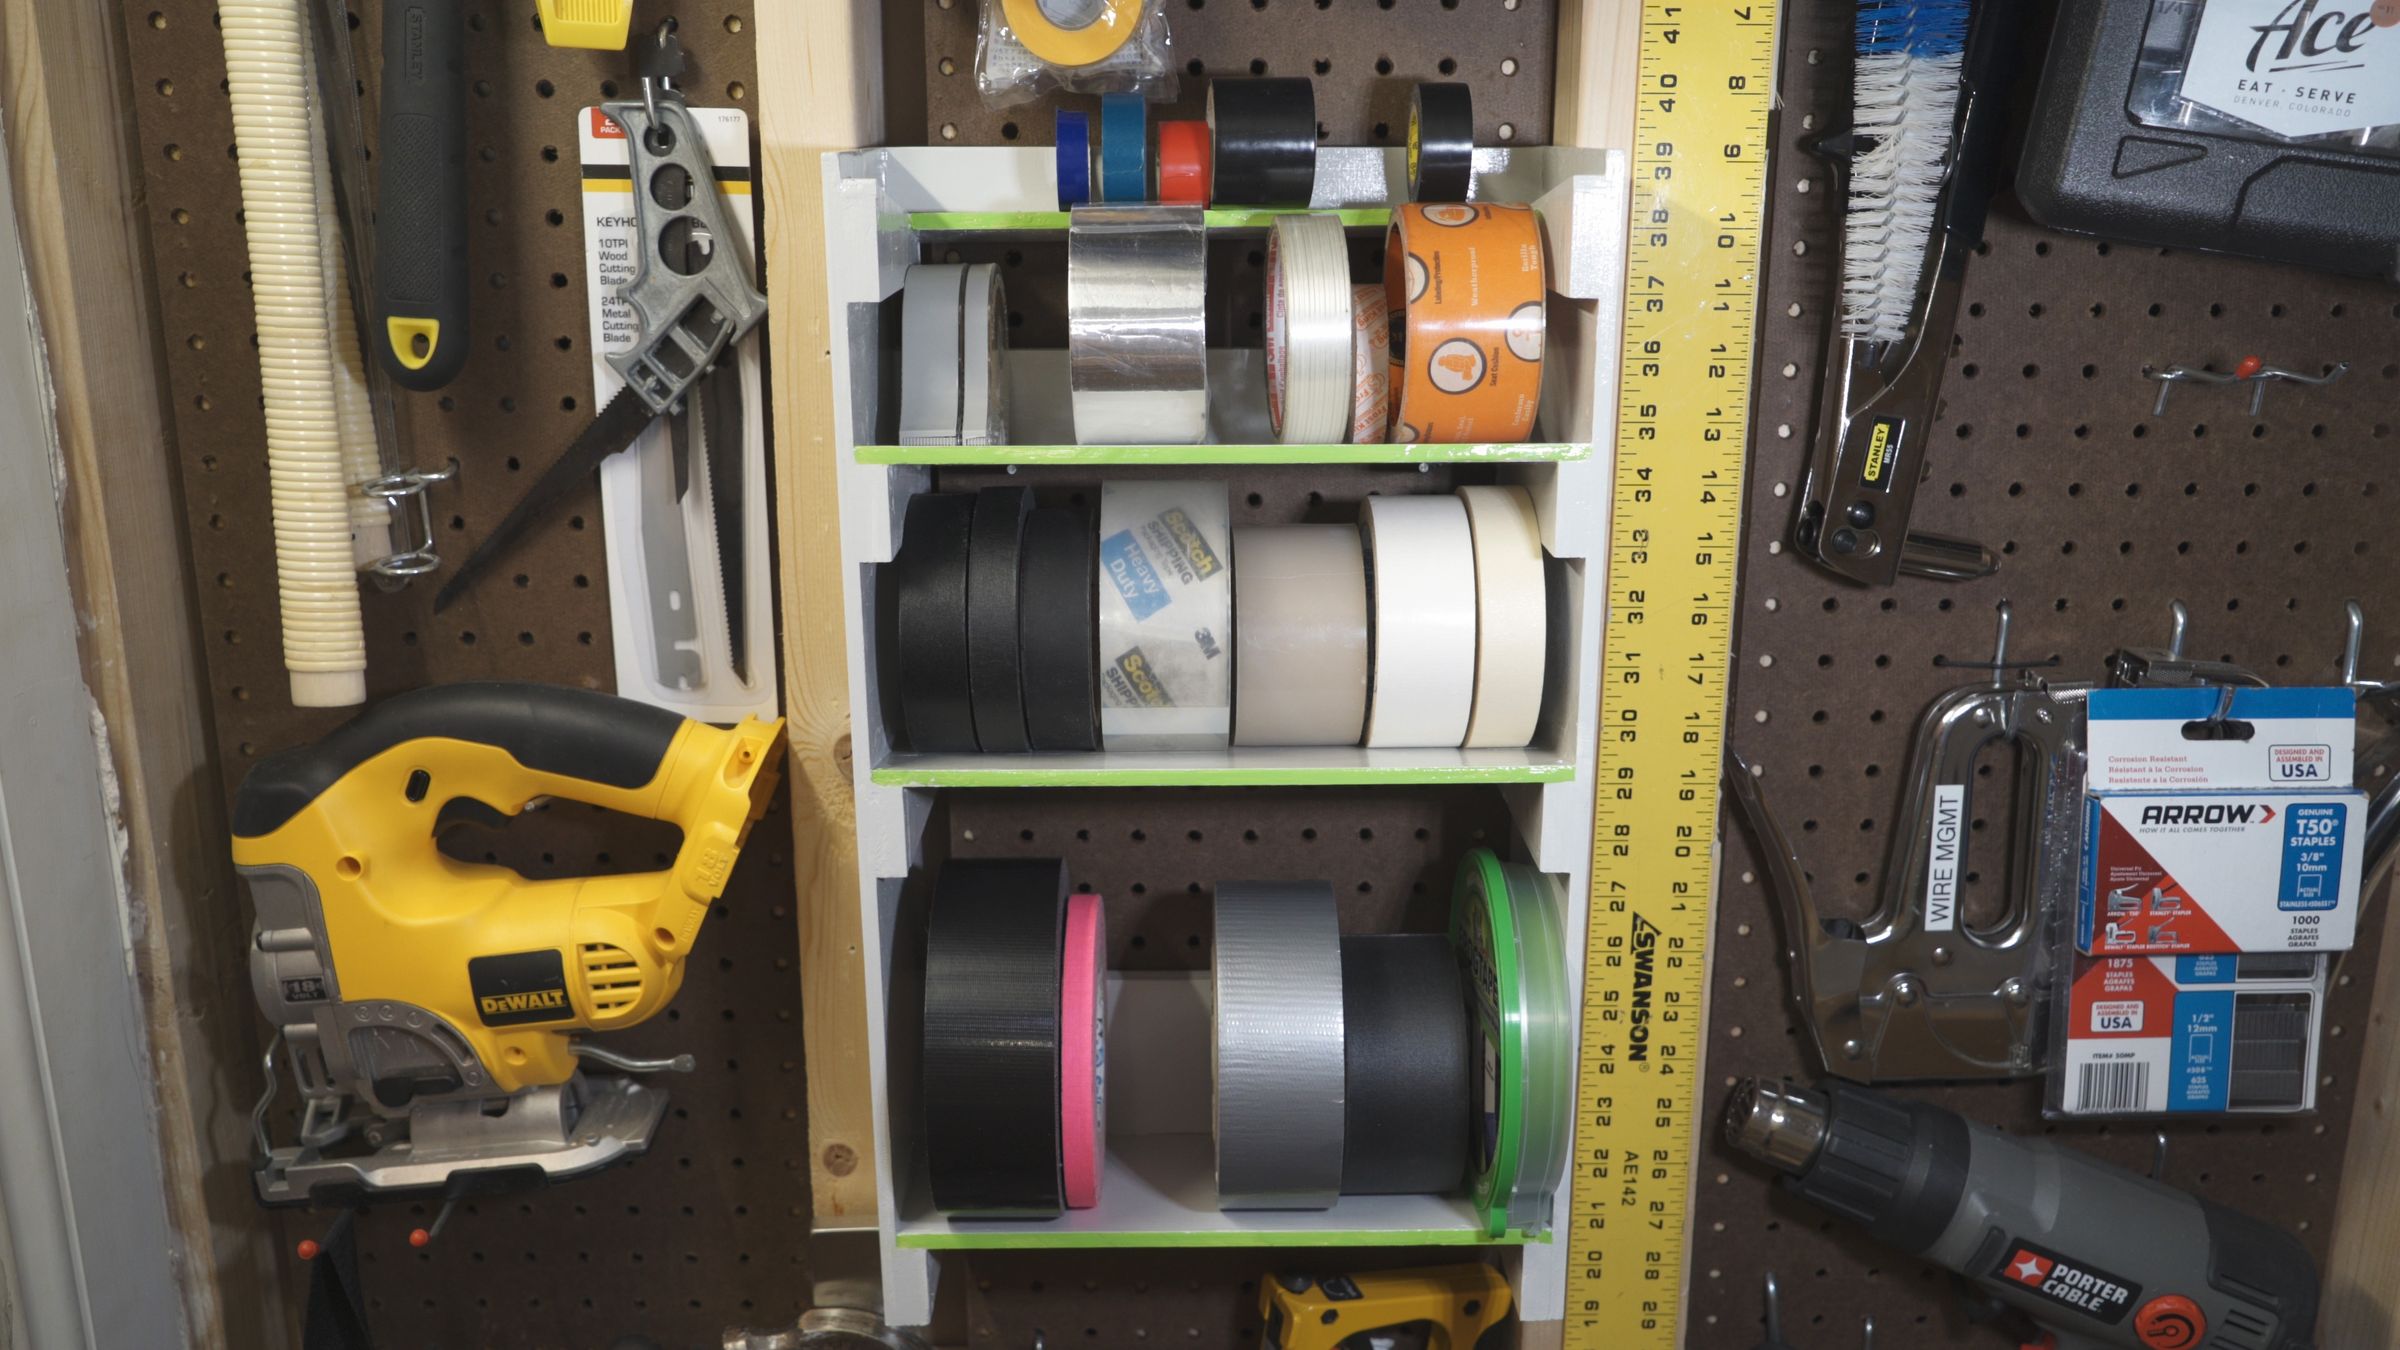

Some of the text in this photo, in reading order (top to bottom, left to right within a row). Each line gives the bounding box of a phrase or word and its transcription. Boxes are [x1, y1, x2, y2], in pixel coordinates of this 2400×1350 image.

[1663, 6, 1682, 44] 41
[1734, 7, 1751, 21] 7
[2245, 0, 2376, 73] Ace
[1659, 73, 1678, 112] 40
[1728, 76, 1746, 90] 8
[2237, 79, 2357, 104] EAT SERVE
[2288, 102, 2351, 118] COLORADO
[1655, 142, 1673, 180] 39
[1724, 145, 1741, 158] 9
[1651, 209, 1669, 246] 38
[1717, 213, 1736, 249] 10
[598, 238, 628, 248] 10TPI
[598, 251, 628, 261] Wood
[599, 263, 636, 276] Cutting
[1647, 275, 1665, 312] 37
[1713, 278, 1731, 312] 11
[602, 308, 632, 318] Metal
[602, 320, 639, 333] Cutting
[603, 333, 632, 343] Blade
[1643, 341, 1661, 377] 36
[1709, 344, 1727, 378] 12
[1639, 404, 1657, 440] 35
[1704, 407, 1722, 441] 13
[1868, 427, 1886, 477] STANLEY
[1635, 467, 1653, 503] 34
[1700, 470, 1718, 504] 14
[1147, 519, 1194, 586] SHIPPING
[1165, 510, 1213, 575] Scotch
[1631, 529, 1649, 564] 33
[1695, 532, 1713, 565] 15
[1109, 557, 1140, 599] Duty
[1124, 542, 1160, 595] Heavy
[1628, 590, 1645, 624] 32
[1691, 593, 1709, 625] 16
[1194, 626, 1222, 660] 3M
[1624, 653, 1641, 683] 31
[1687, 653, 1705, 684] 17
[1620, 710, 1637, 742] 30
[1683, 712, 1700, 743] 18
[2108, 755, 2188, 763] Corrosion Resistant
[2281, 763, 2318, 778] USA
[1617, 767, 1634, 800] 29
[1679, 770, 1696, 801] 19
[2141, 804, 2256, 825] ARROW
[2298, 808, 2333, 816] GENUINE
[1613, 825, 1630, 856] 28
[1675, 826, 1692, 857] 20
[2290, 836, 2336, 847] STAPLES
[1930, 795, 1959, 922] WIRE MGMT
[2296, 863, 2328, 872] 10mm
[2300, 852, 2325, 862] 3/8"
[1610, 881, 1626, 912] 27
[1671, 882, 1688, 912] 21
[2292, 915, 2321, 925] 1000
[1606, 936, 1623, 967] 26
[1667, 937, 1684, 967] 22
[2108, 958, 2134, 968] 1875
[1603, 991, 1619, 1021] 25
[1628, 932, 1655, 1062] SWANSON
[1663, 992, 1680, 1022] 23
[2100, 1016, 2132, 1029] USA
[2187, 1024, 2218, 1033] 12mm
[2192, 1013, 2214, 1023] 1/2"
[1600, 1044, 1615, 1074] 24
[1659, 1045, 1676, 1075] 24
[1596, 1097, 1612, 1126] 23
[1655, 1098, 1672, 1128] 25
[1593, 1149, 1609, 1178] 22
[1621, 1150, 1640, 1206] AE142
[1652, 1150, 1668, 1179] 26
[1590, 1201, 1606, 1229] 21
[1649, 1201, 1665, 1229] 27
[1587, 1251, 1602, 1279] 20
[1645, 1252, 1661, 1279] 28
[2042, 1279, 2104, 1312] CABLE
[2052, 1263, 2129, 1305] PORTER
[1584, 1301, 1599, 1327] 19
[1642, 1301, 1657, 1329] 29
